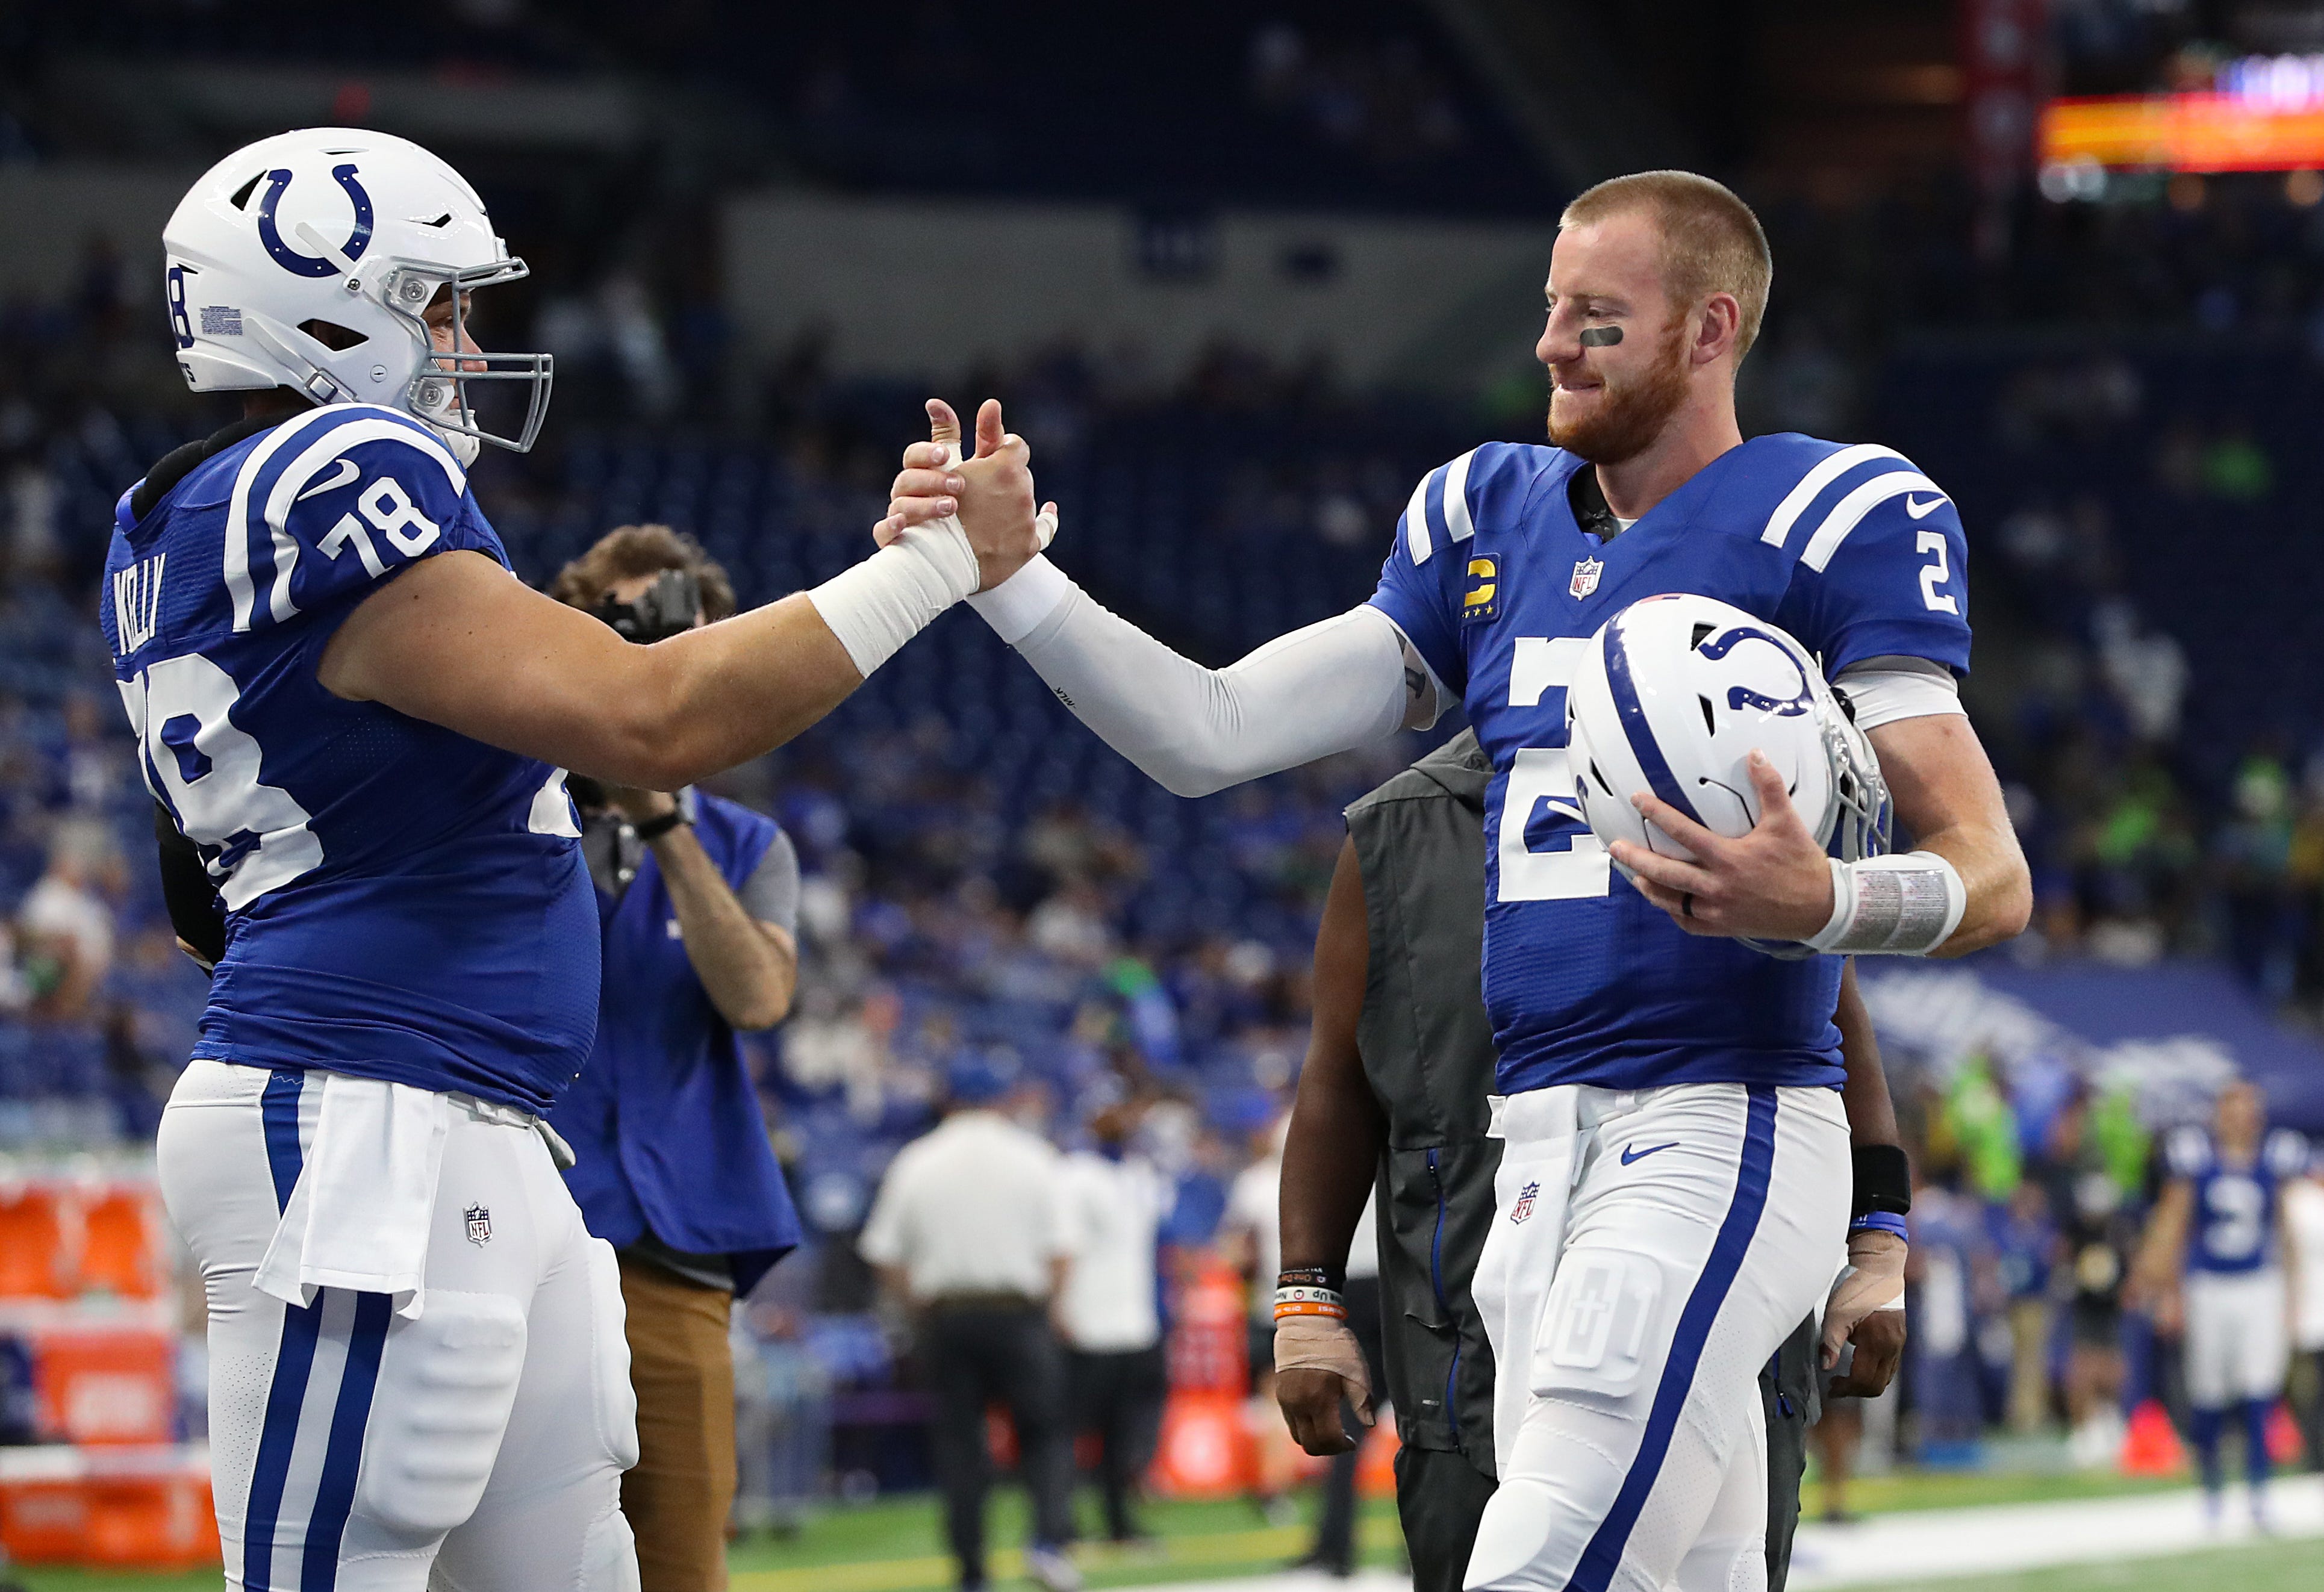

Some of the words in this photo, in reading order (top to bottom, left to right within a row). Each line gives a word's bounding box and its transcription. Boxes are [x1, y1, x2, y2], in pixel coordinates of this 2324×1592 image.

[317, 477, 441, 579] 78
[1574, 576, 1592, 592] NFL
[1916, 530, 1959, 615] 2
[1497, 637, 1611, 902] 2
[470, 1222, 489, 1237] NFL
[1512, 1199, 1533, 1219] NFL
